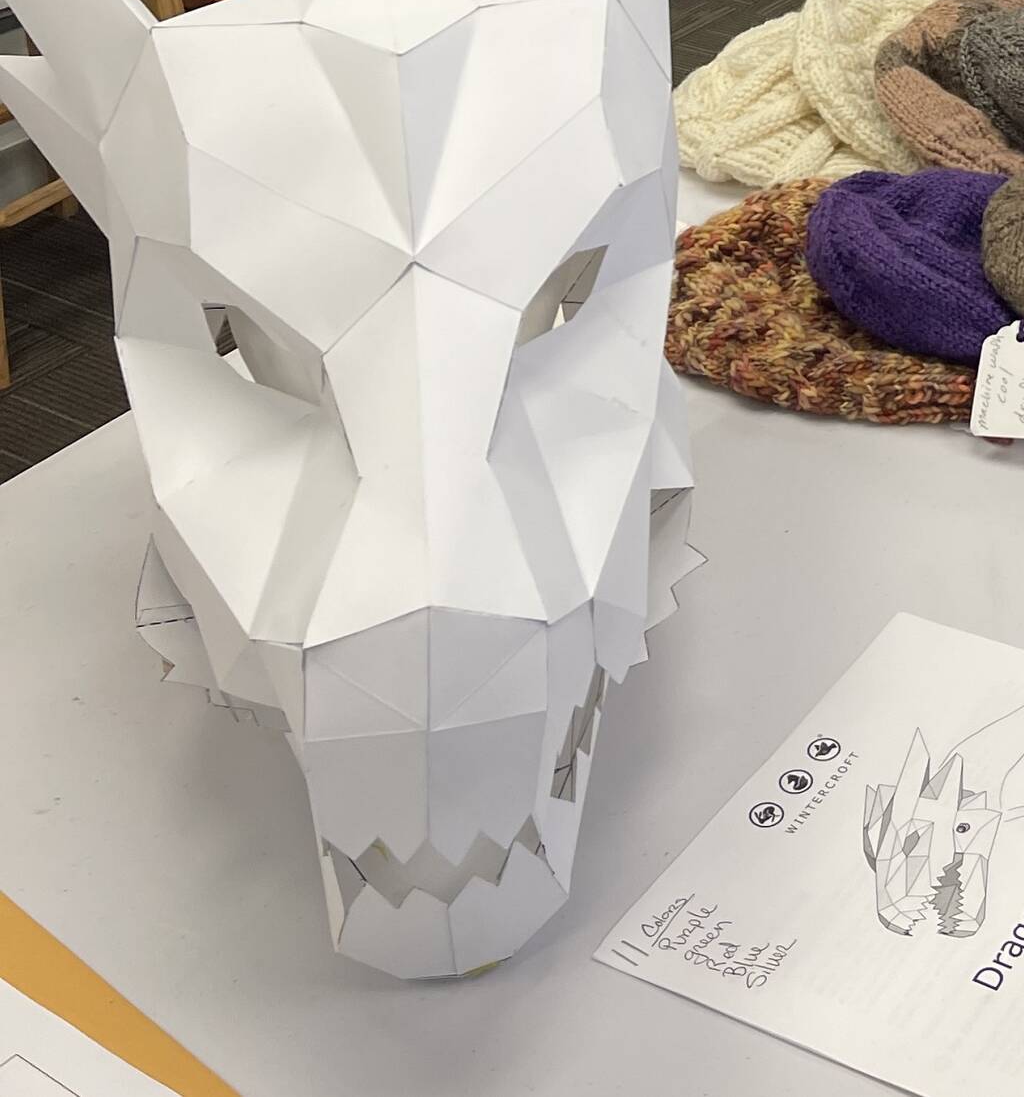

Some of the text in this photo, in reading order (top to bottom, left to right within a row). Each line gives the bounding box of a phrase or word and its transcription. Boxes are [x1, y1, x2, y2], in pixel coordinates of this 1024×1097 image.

[977, 335, 1004, 430] machine wash
[998, 367, 1013, 404] cool
[783, 750, 859, 834] WINTERCROFT
[641, 898, 688, 938] Colors
[658, 904, 718, 951] Purple
[685, 921, 733, 965] green
[707, 942, 741, 972] Red
[723, 943, 770, 977] Blue
[747, 939, 797, 988] Silver
